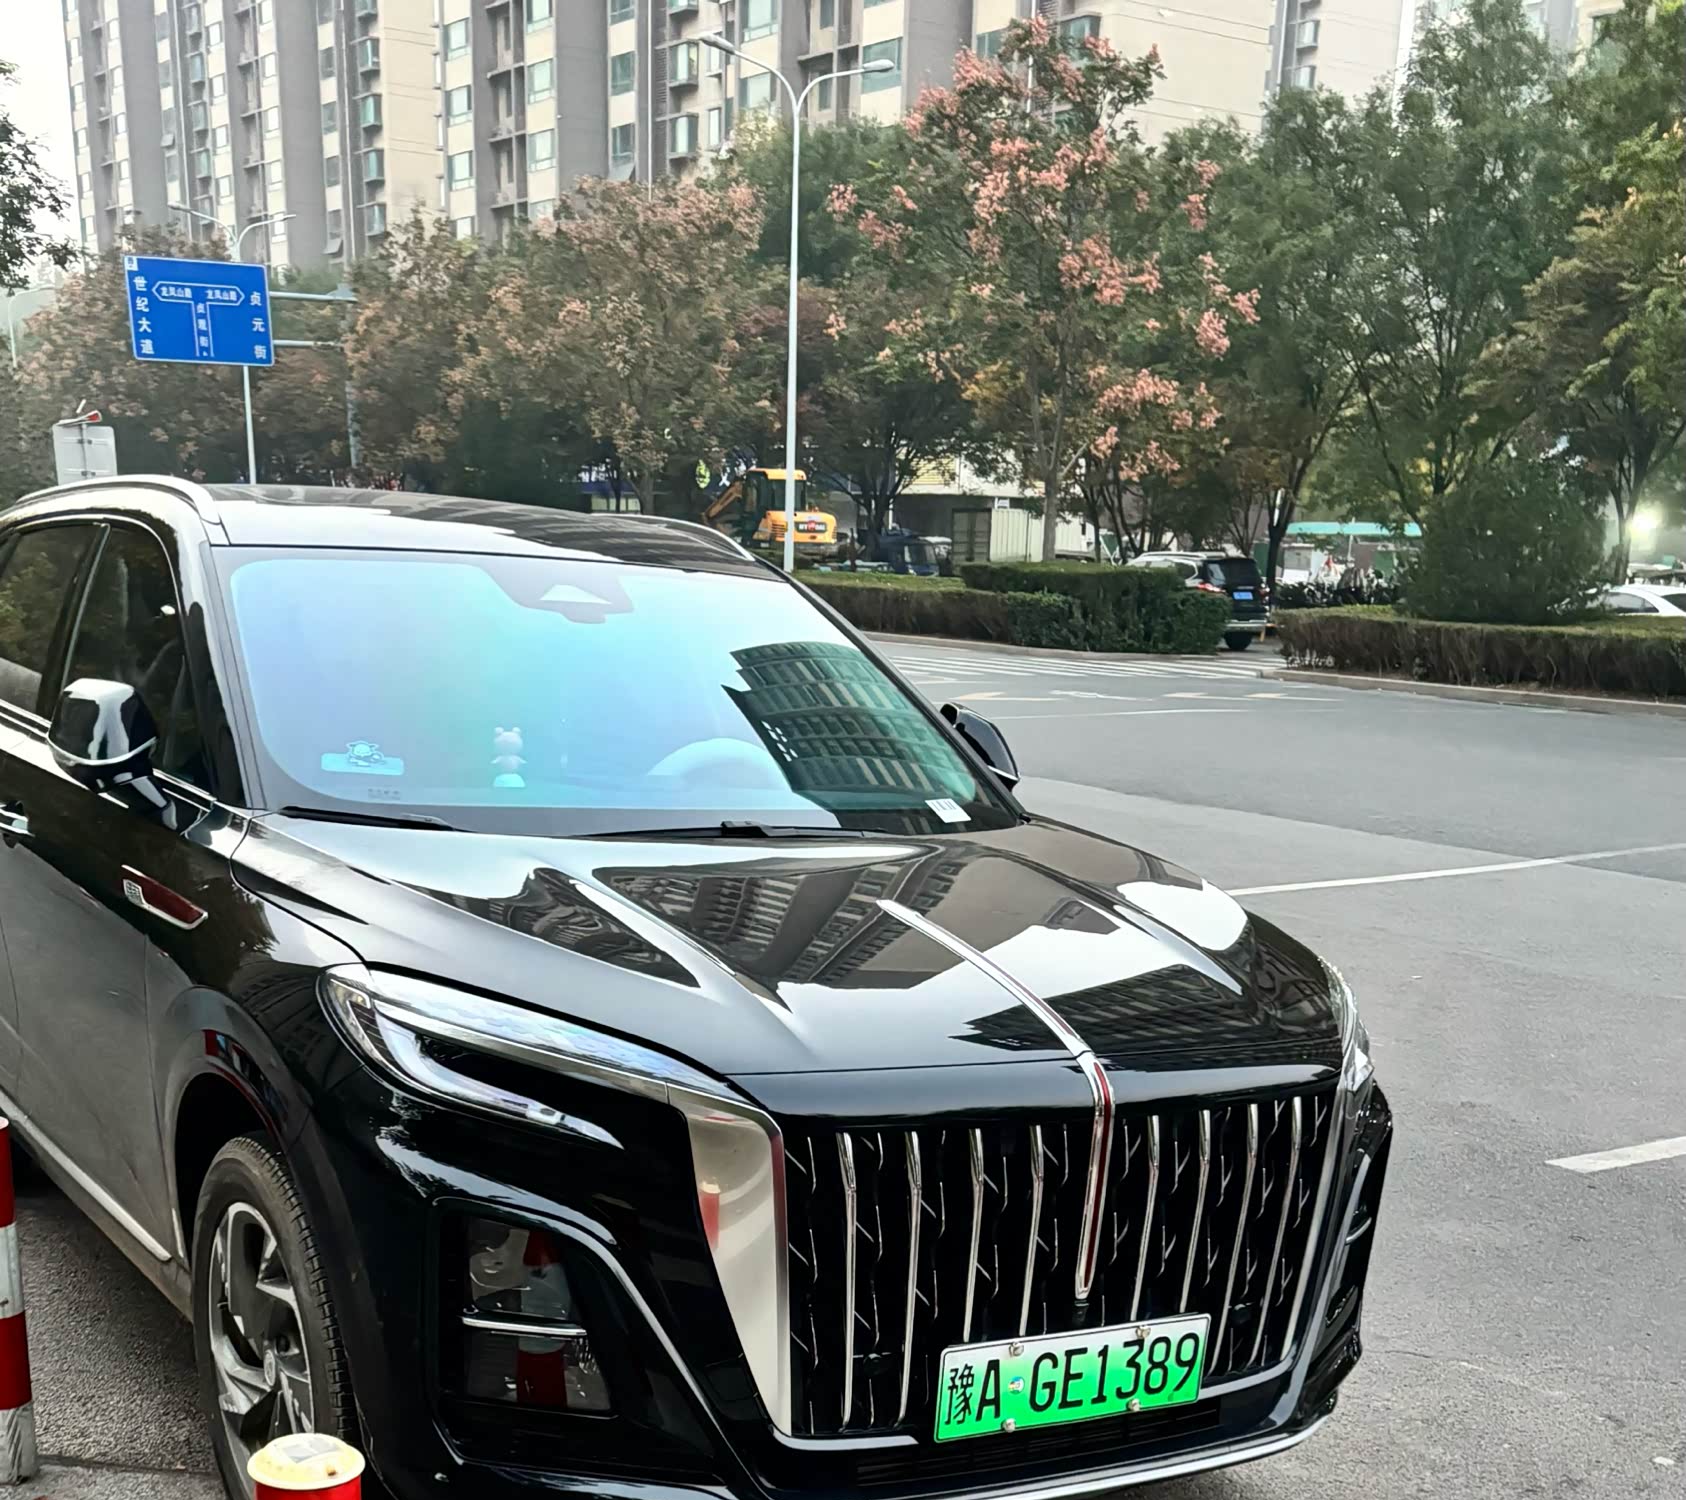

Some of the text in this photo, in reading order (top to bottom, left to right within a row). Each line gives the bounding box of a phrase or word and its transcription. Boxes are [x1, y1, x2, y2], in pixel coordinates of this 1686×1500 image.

[133, 276, 155, 355] 世纪大道
[250, 291, 267, 360] 贞元街
